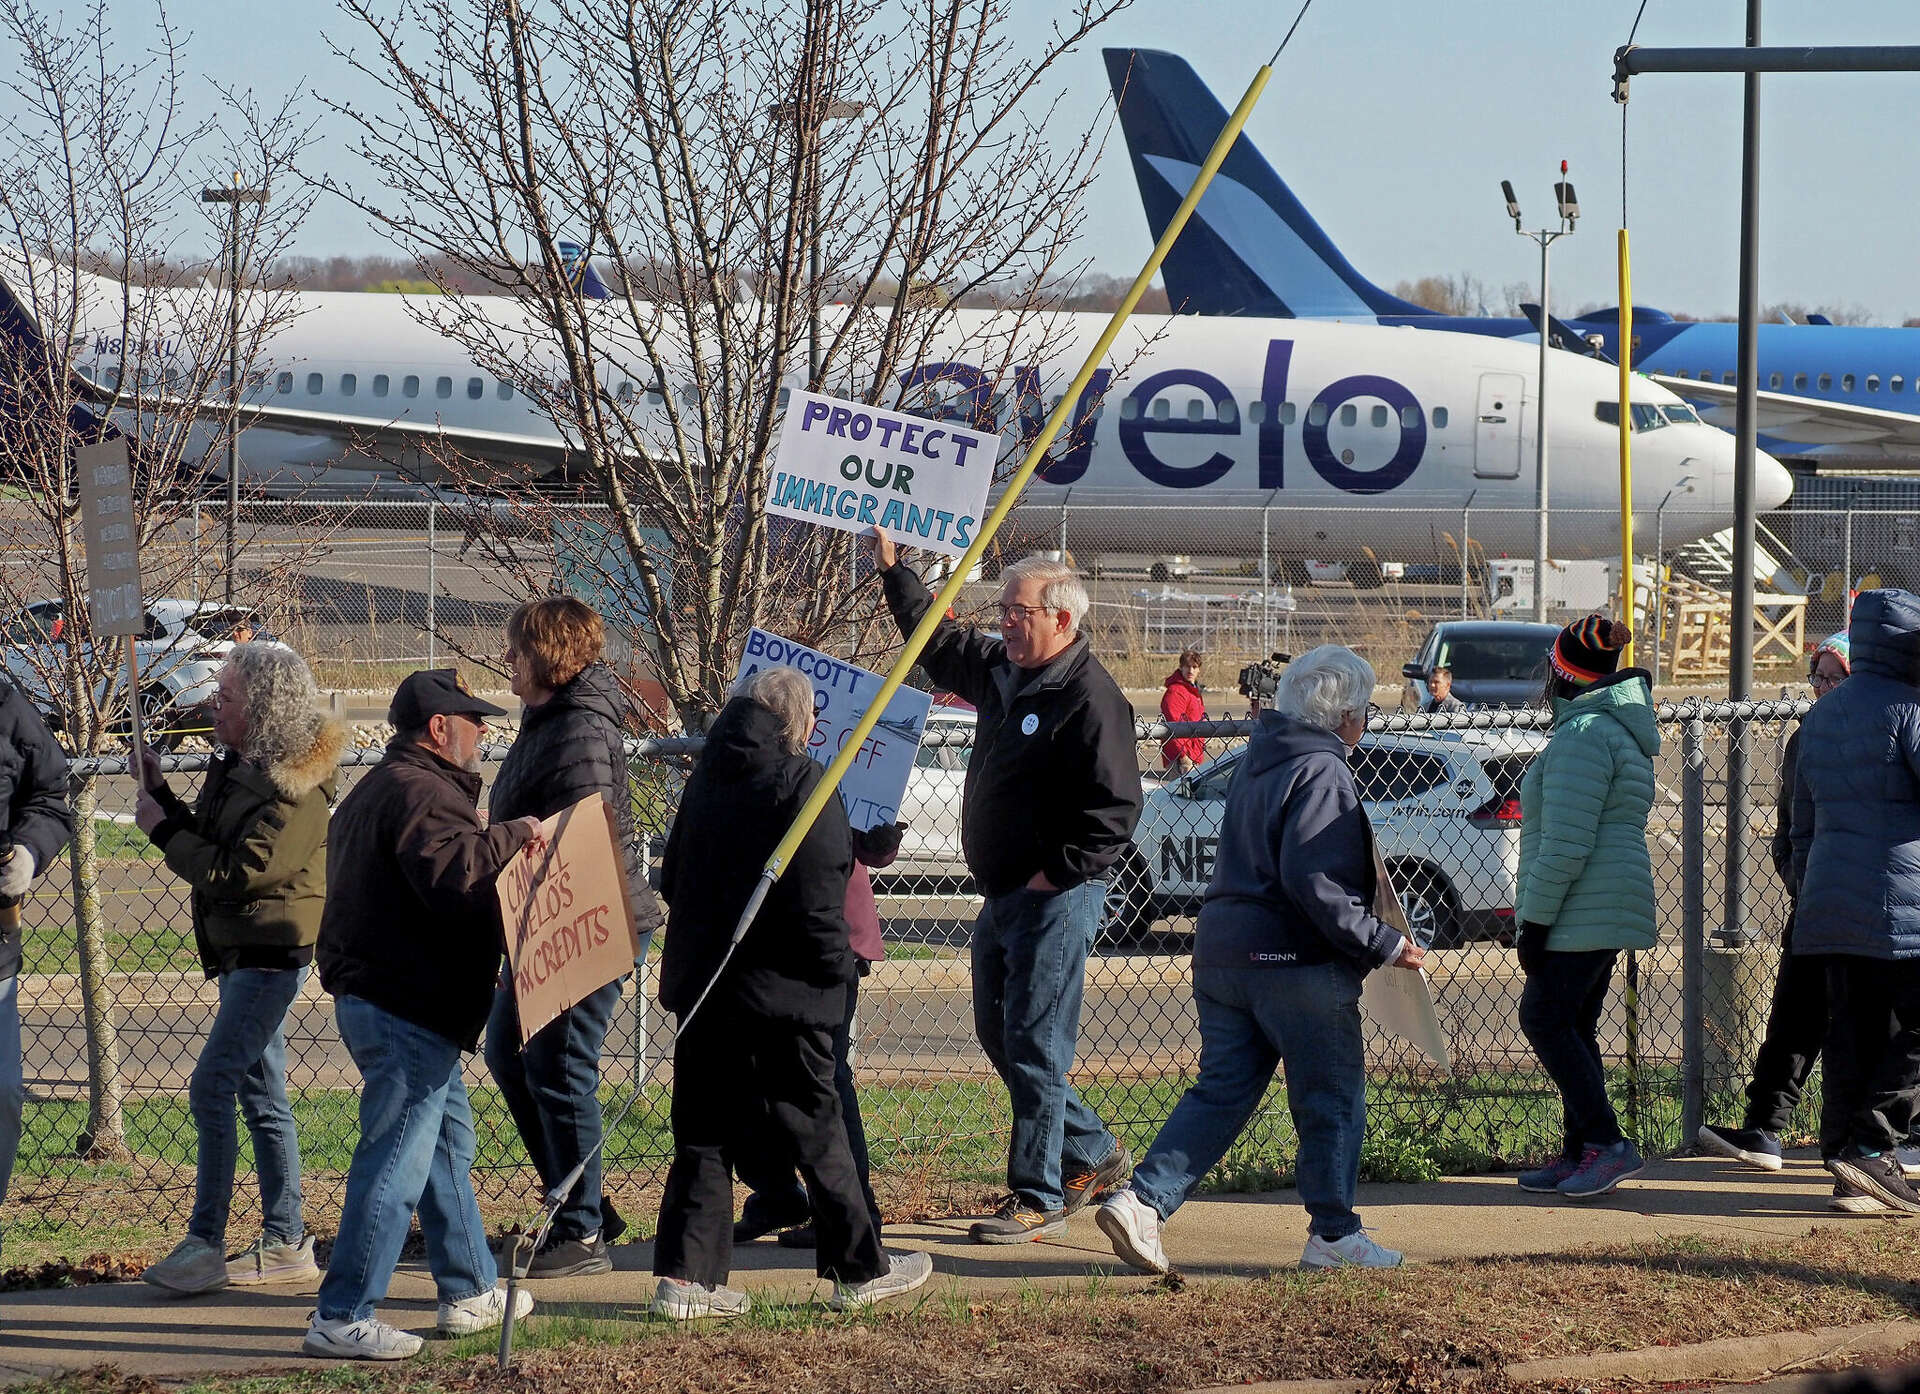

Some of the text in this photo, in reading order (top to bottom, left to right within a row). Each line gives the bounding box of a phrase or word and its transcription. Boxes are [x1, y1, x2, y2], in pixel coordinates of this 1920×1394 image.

[801, 400, 978, 467] PROTECT
[840, 454, 914, 495] OUR
[771, 472, 975, 549] IMMIGRANTS
[747, 630, 864, 694] BOYCOTT
[1456, 783, 1474, 793] ab
[1161, 834, 1219, 883] NE
[534, 904, 609, 985] CREDITS
[1249, 952, 1296, 961] UCONN
